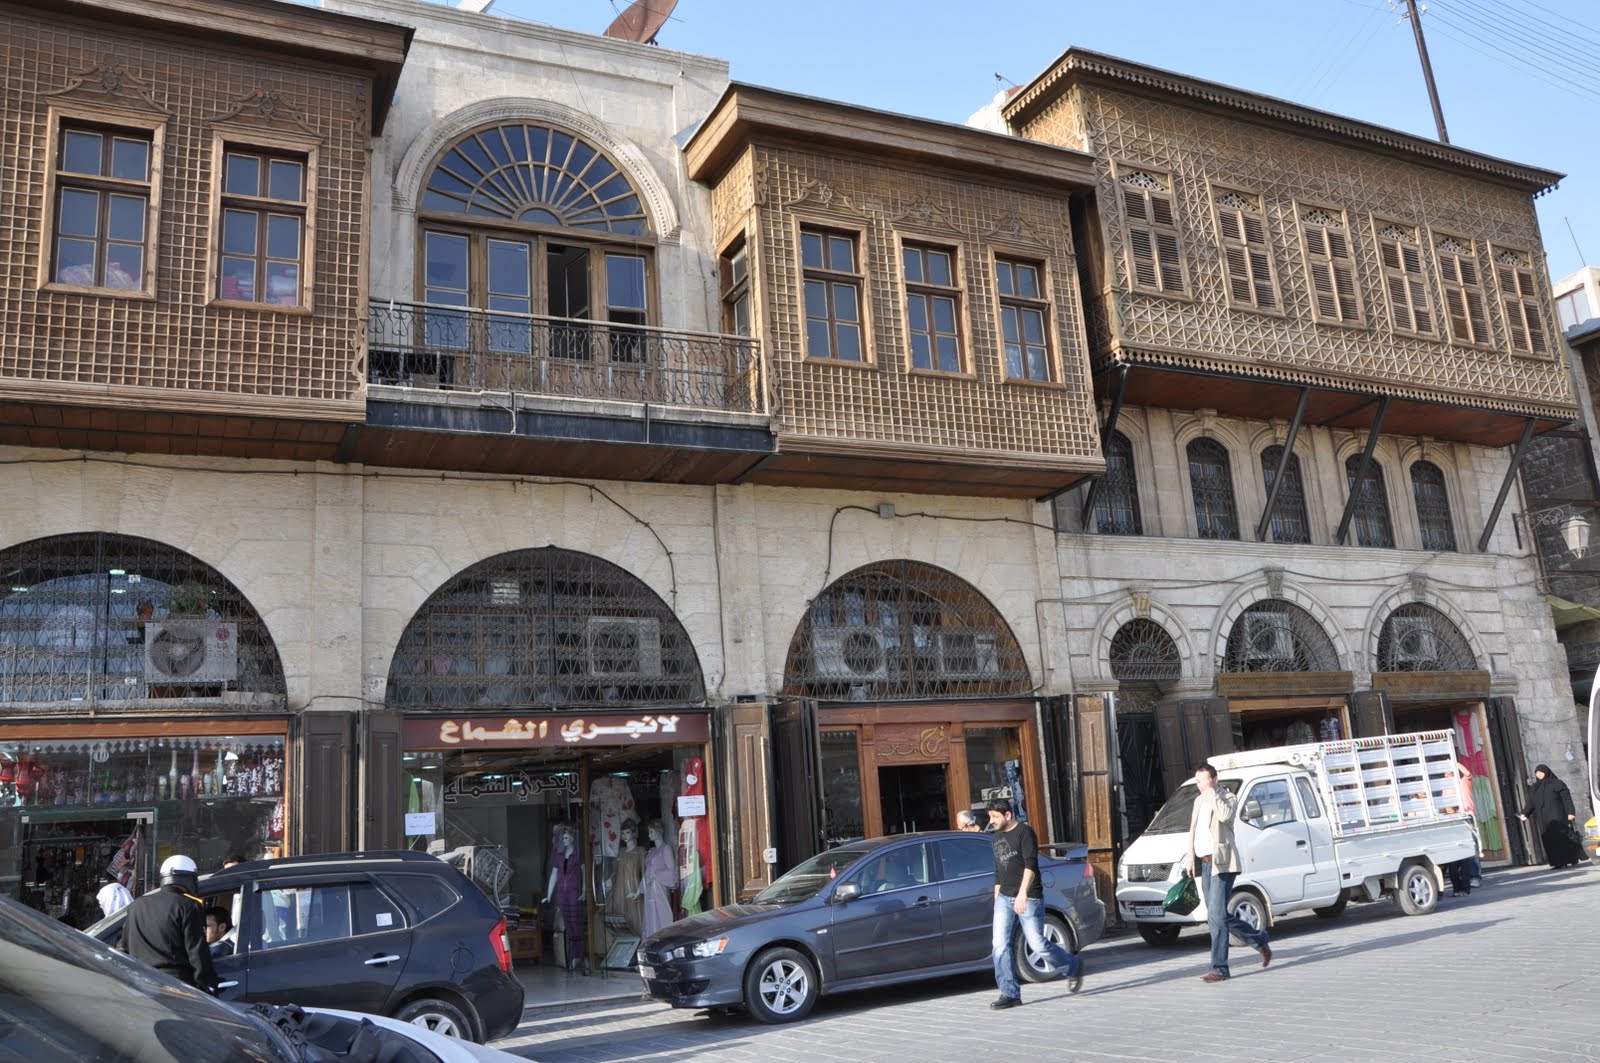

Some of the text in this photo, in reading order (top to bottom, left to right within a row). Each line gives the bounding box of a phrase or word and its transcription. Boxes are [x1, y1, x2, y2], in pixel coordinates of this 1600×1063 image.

[439, 715, 681, 744] لانجري الشماع
[444, 774, 513, 804] الشماع
